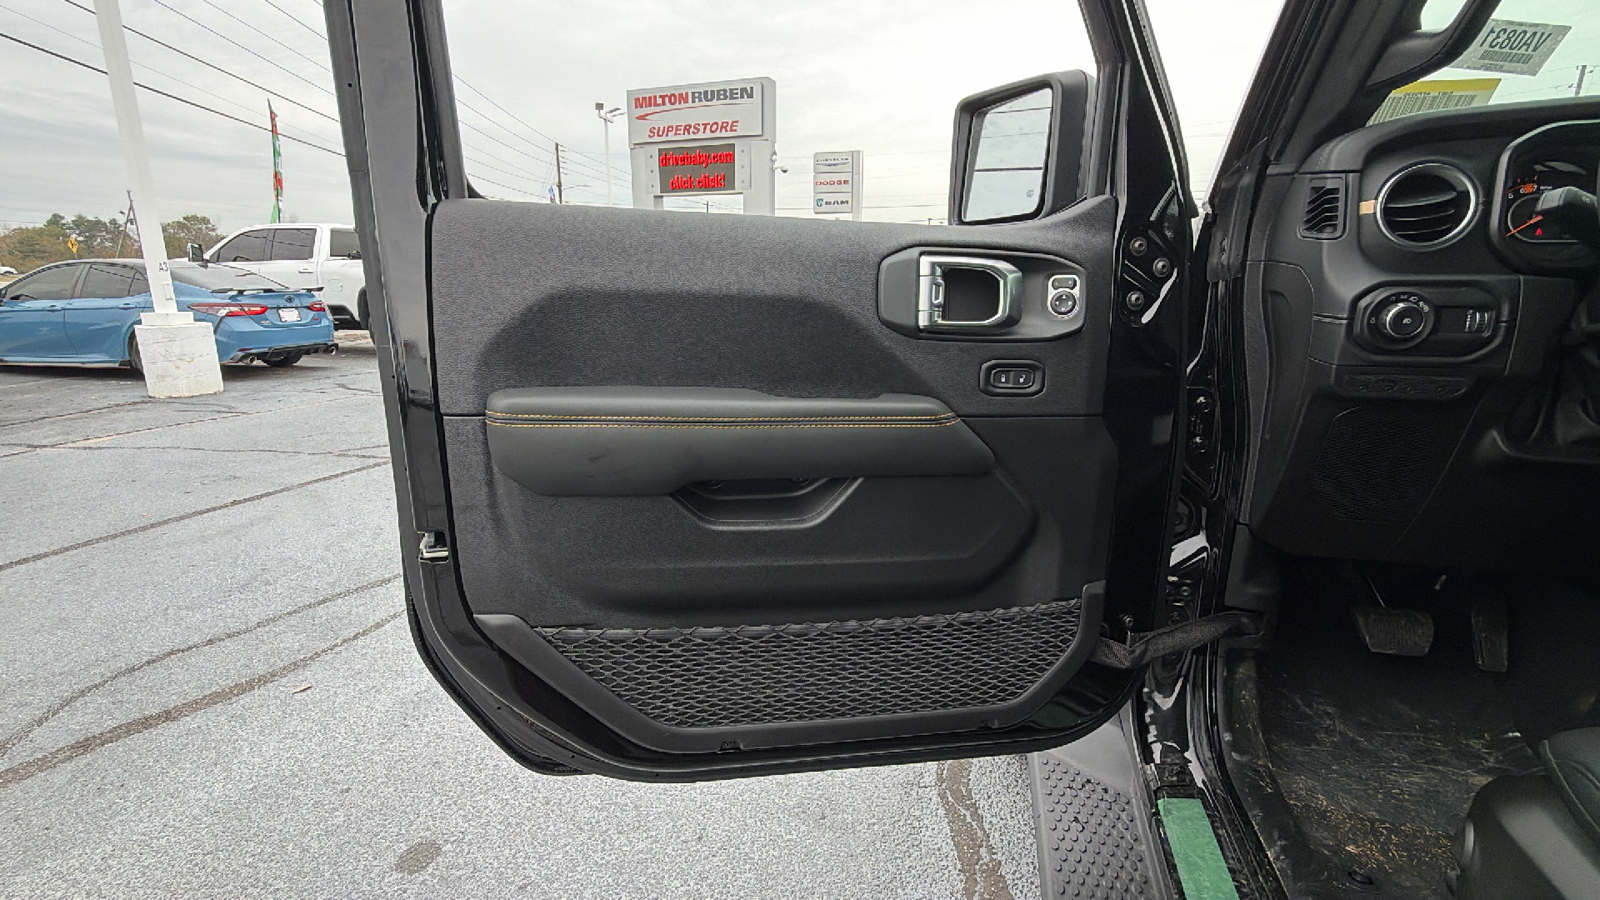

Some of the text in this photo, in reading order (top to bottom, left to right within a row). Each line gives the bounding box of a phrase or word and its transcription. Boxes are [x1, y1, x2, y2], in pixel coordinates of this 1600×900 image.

[633, 86, 754, 109] MILTON RUBEN
[647, 120, 739, 138] SUPERSTORE
[659, 150, 734, 168] drivebaby.com
[669, 173, 726, 190] click click!
[159, 261, 169, 272] A3
